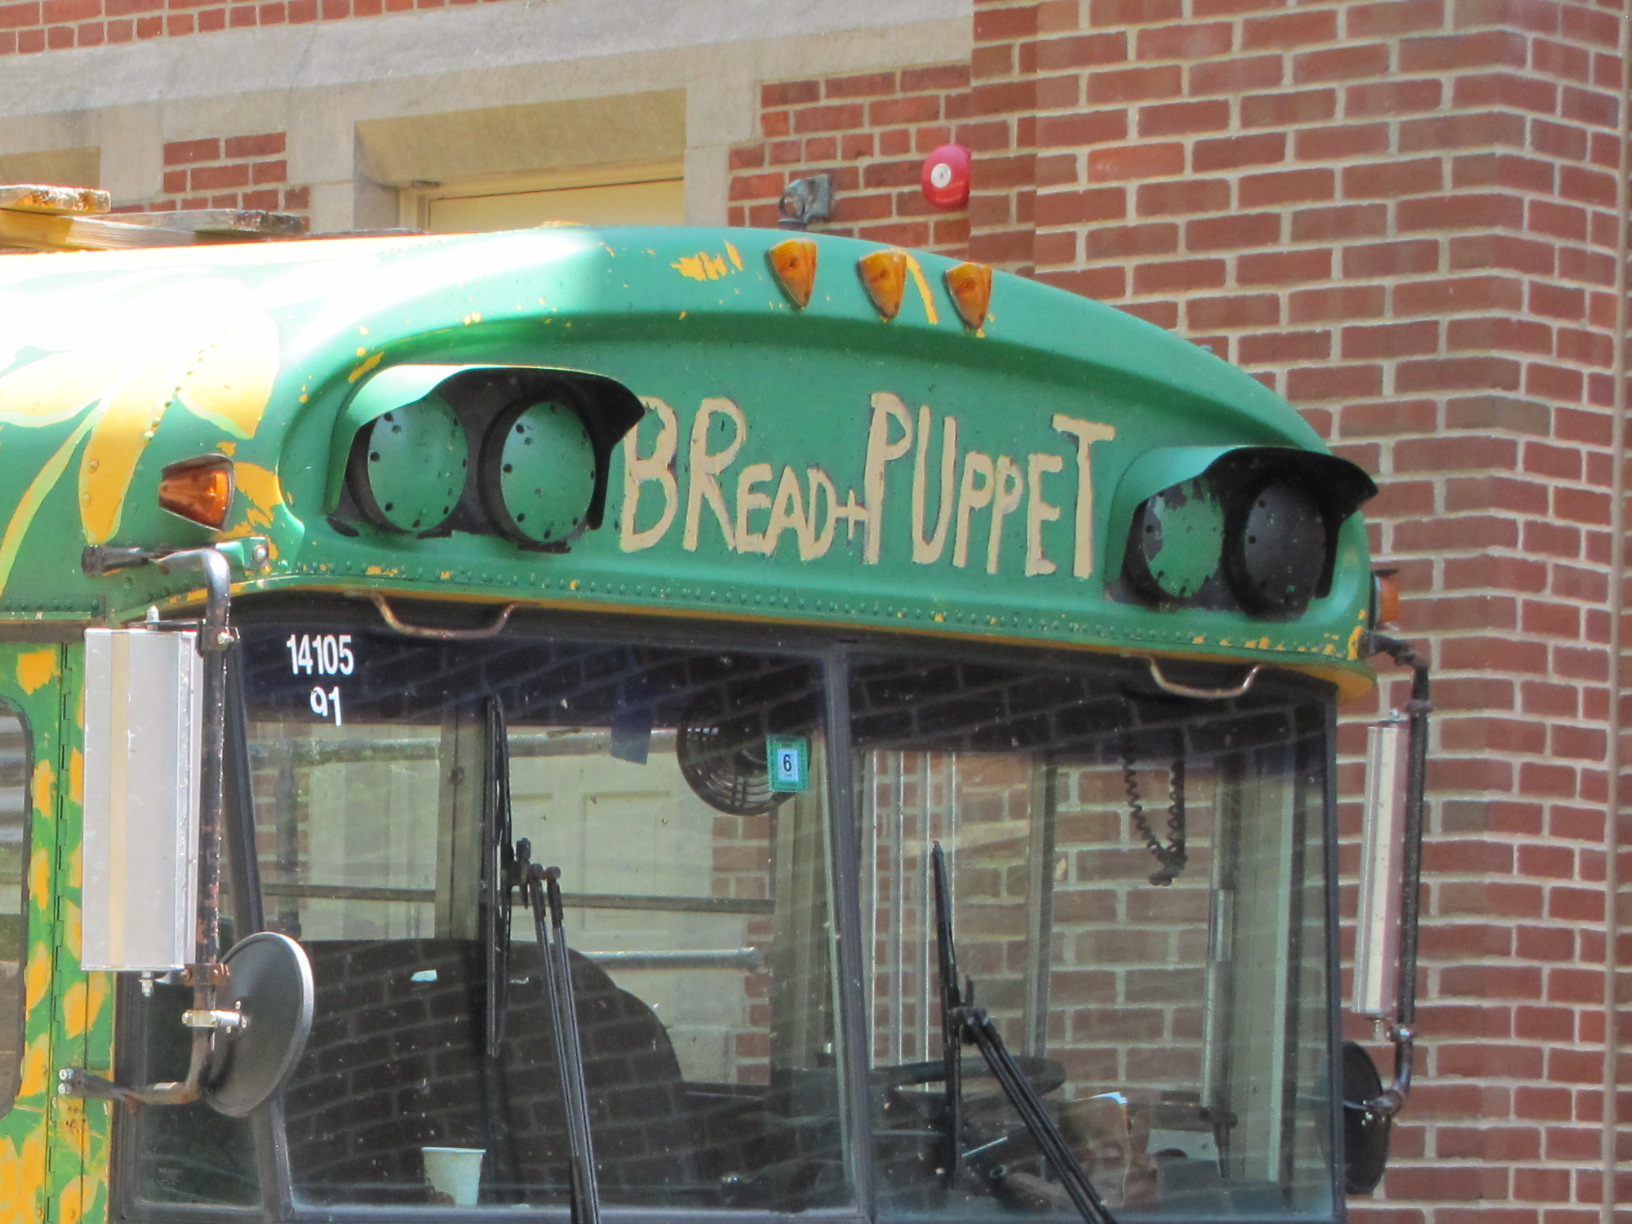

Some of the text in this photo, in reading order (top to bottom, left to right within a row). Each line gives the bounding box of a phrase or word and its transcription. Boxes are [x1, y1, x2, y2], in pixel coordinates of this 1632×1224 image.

[286, 633, 355, 675] 14105
[310, 685, 342, 727] 91
[782, 753, 793, 773] 6
